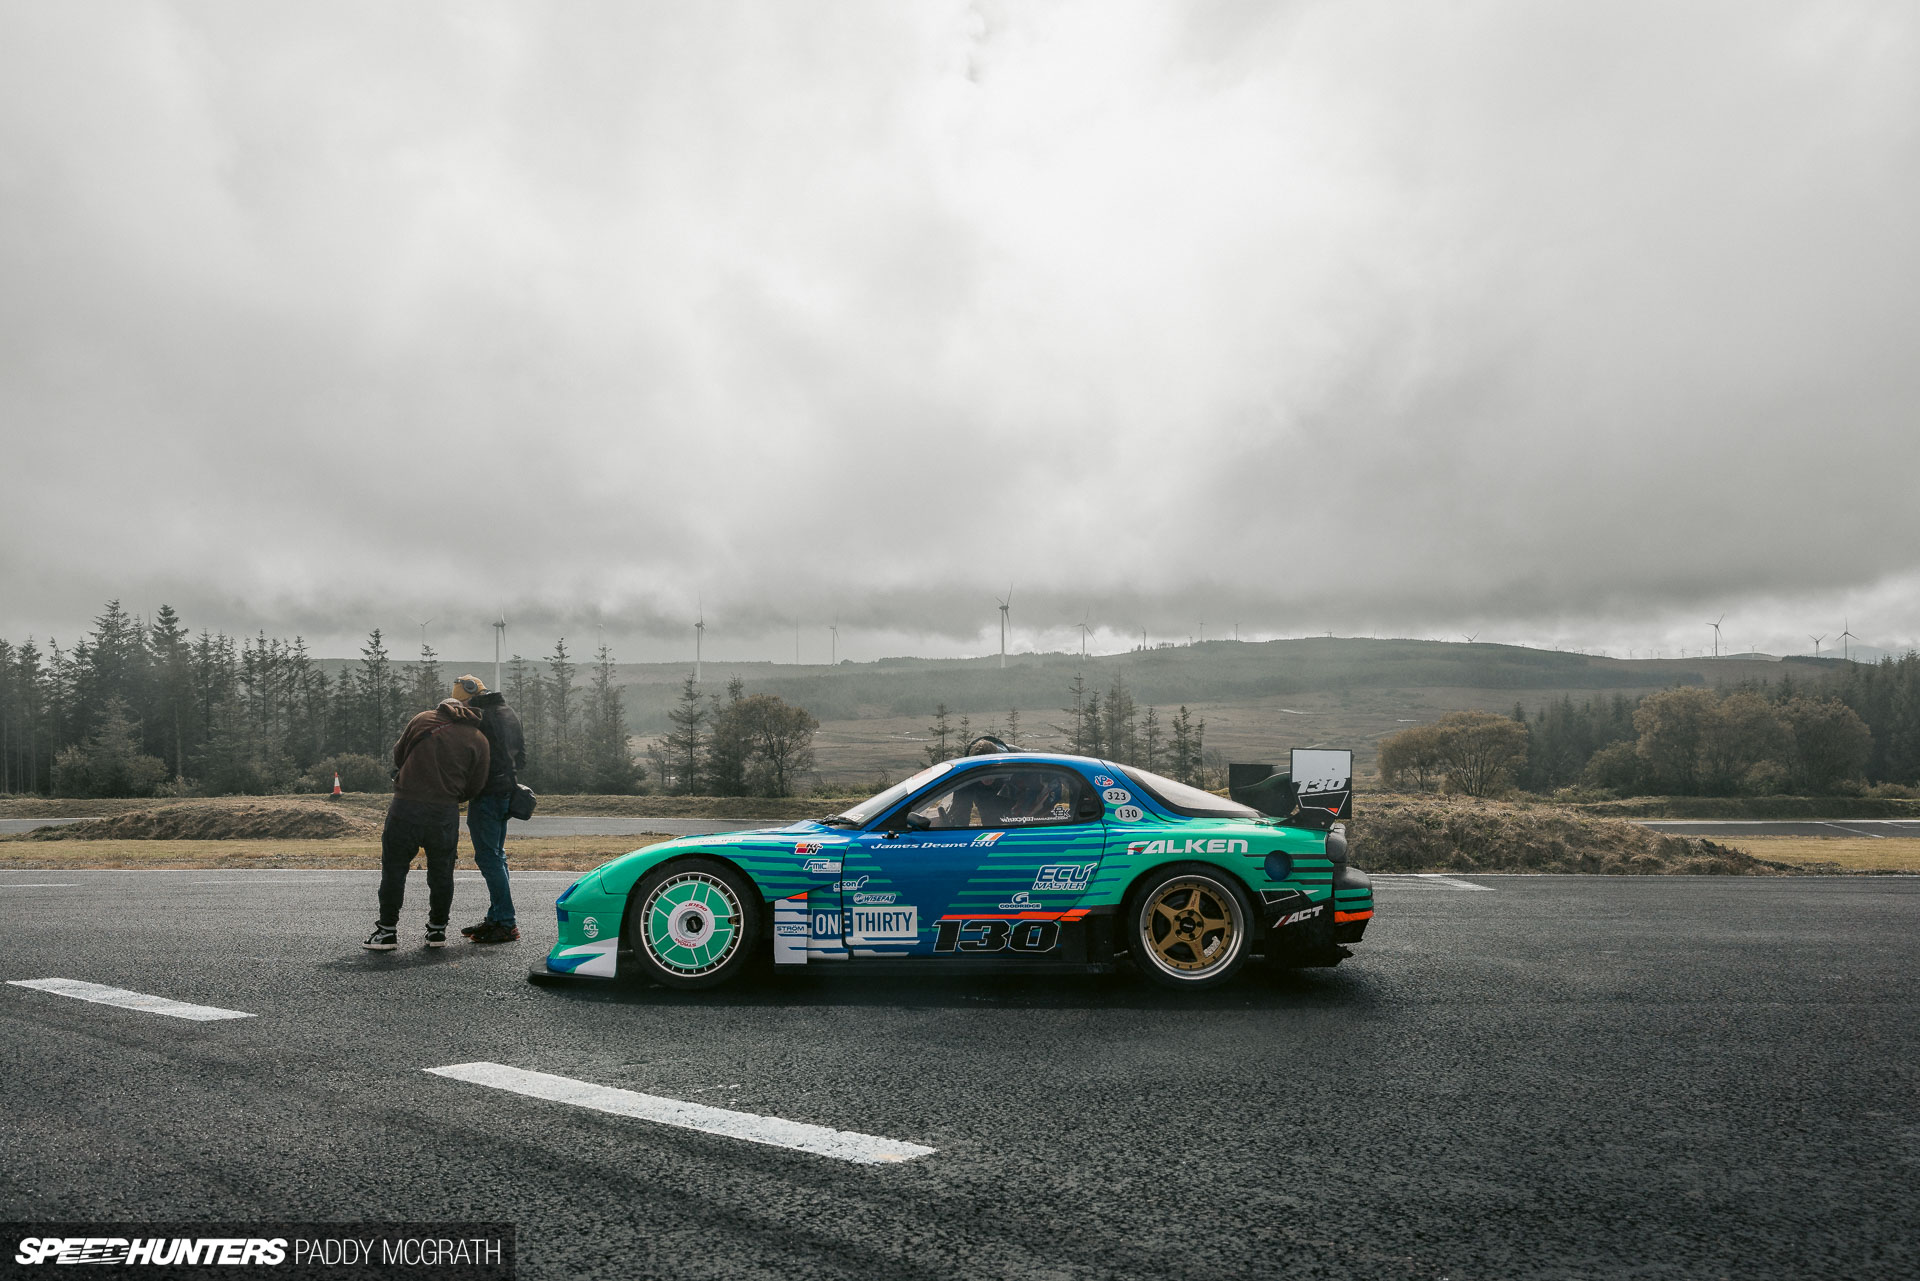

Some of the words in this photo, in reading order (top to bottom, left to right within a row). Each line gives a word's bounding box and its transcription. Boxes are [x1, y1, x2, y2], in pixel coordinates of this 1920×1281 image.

[1297, 778, 1347, 793] 130
[1107, 791, 1127, 801] 323
[1119, 809, 1138, 818] 130
[1126, 839, 1248, 855] FALKEN
[1036, 863, 1098, 882] ECU
[1033, 882, 1087, 890] MASTER
[816, 913, 851, 935] ONE
[855, 912, 913, 932] THIRTY
[1284, 905, 1323, 926] ACT
[932, 919, 1060, 952] 130
